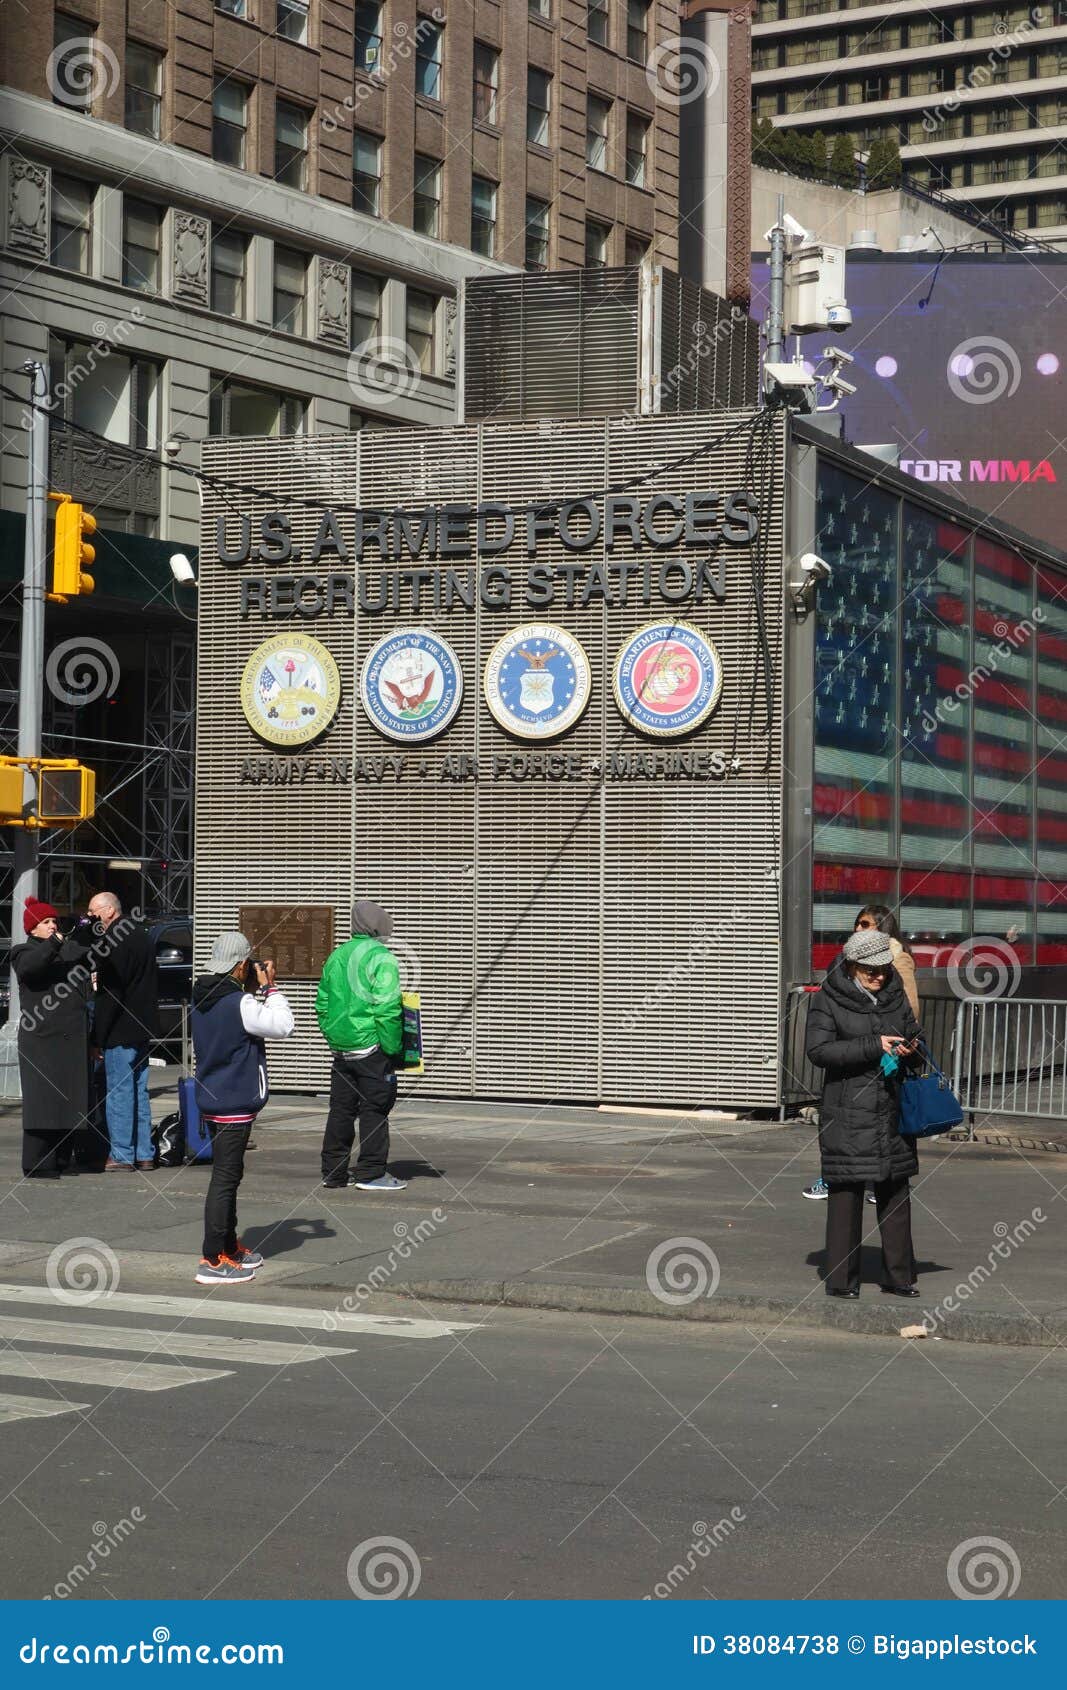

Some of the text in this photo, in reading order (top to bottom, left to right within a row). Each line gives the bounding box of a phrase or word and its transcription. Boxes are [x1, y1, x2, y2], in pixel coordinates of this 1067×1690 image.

[969, 460, 1057, 482] MMA
[216, 491, 758, 562] U.S. ARMED FORCES
[240, 558, 727, 614] RECRUITING STATION
[369, 638, 453, 681] DEPARTMENT OF THE NAVY
[488, 628, 587, 699] DEPARTMENT OF THE AIR FORCE
[622, 629, 668, 677] DEPARTMENT
[682, 633, 695, 646] THE
[696, 645, 712, 672] NAVY
[370, 689, 453, 731] UNITED STATES OF AMERICA
[642, 712, 667, 725] STATES
[670, 707, 699, 724] MARINE
[697, 681, 711, 706] CORPS
[239, 751, 726, 781] ARMY NAVY AIR FORCE MARINES
